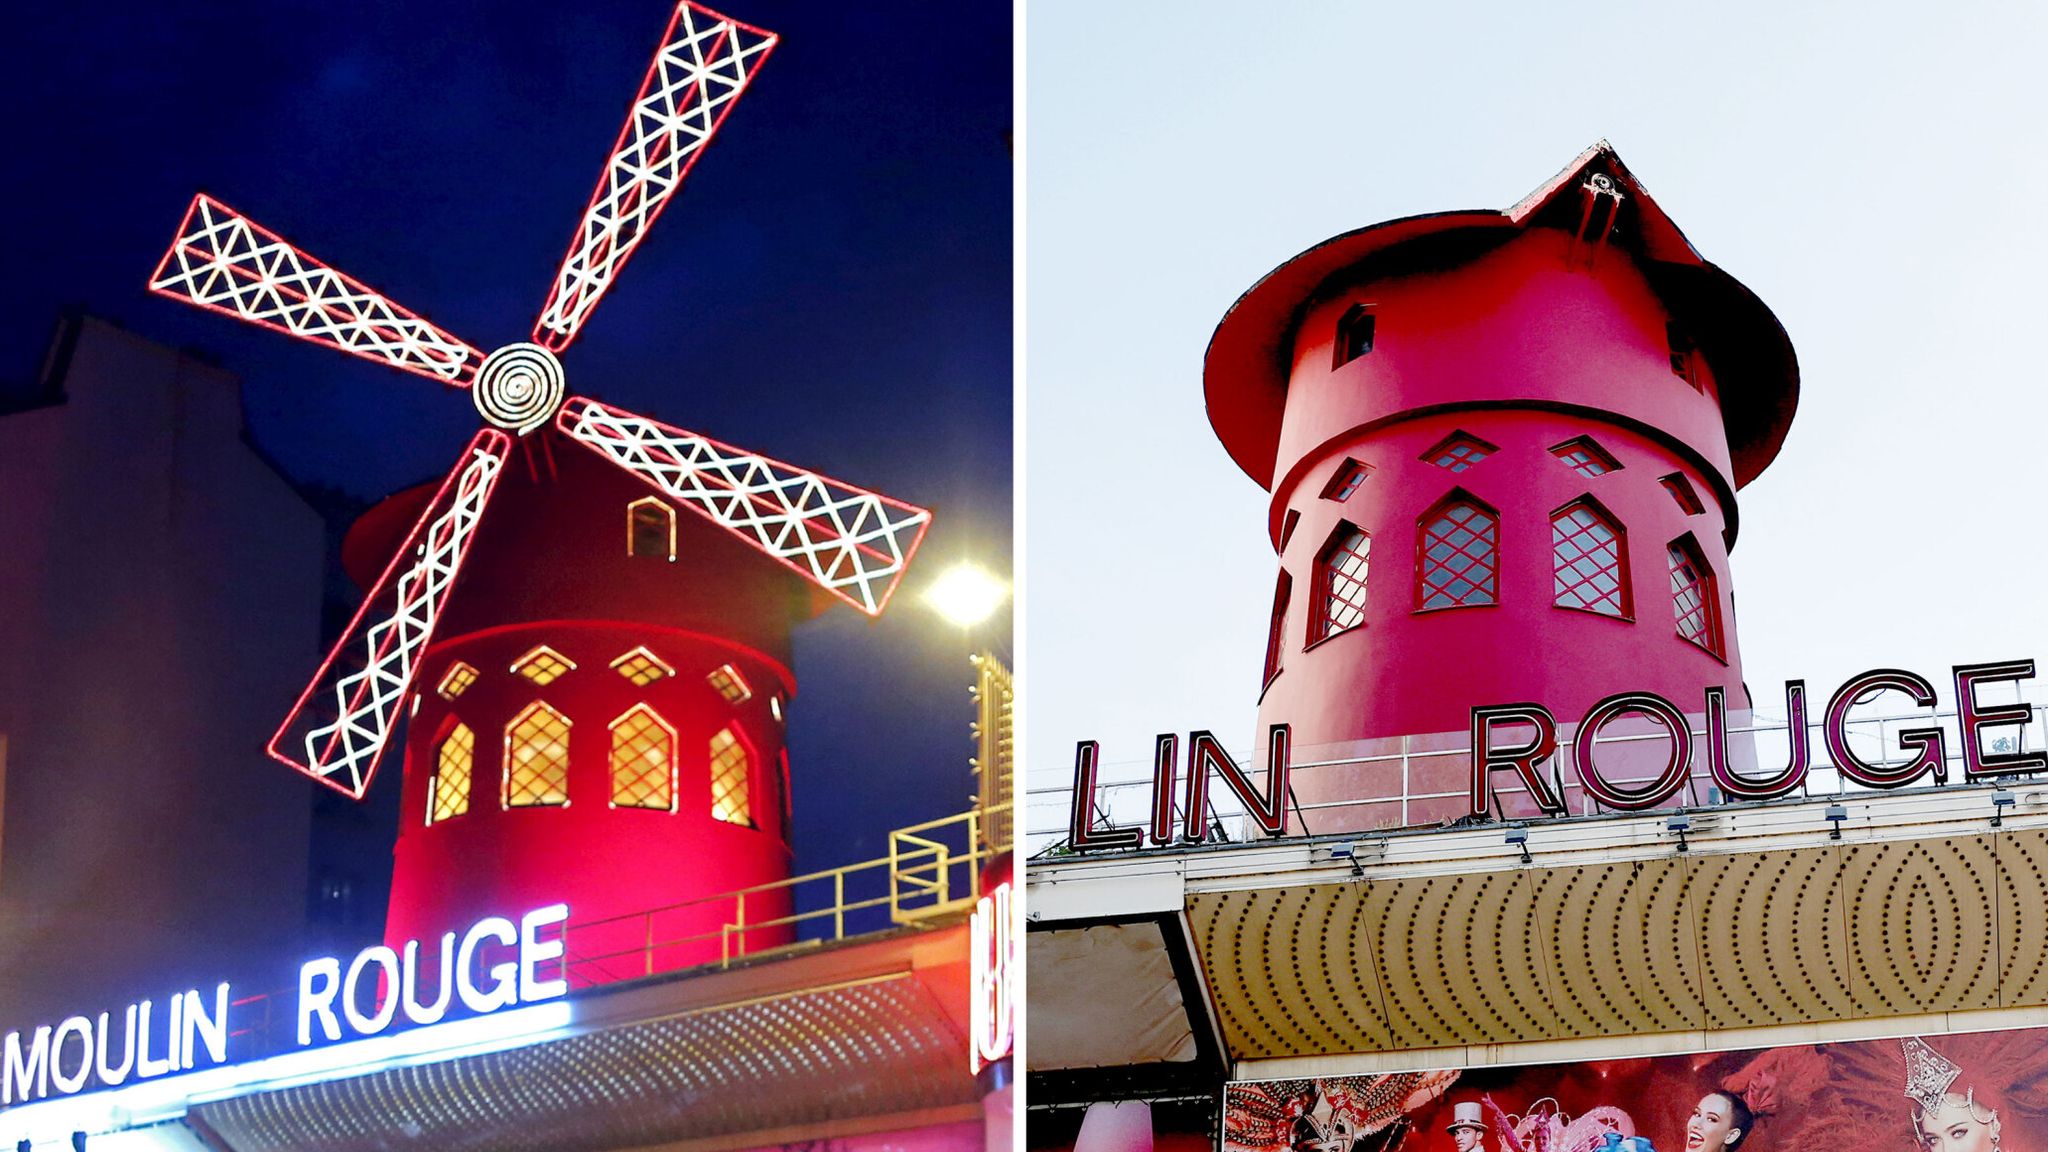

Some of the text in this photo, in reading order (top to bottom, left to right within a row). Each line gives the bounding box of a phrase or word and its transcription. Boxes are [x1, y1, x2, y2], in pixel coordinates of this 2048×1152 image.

[1470, 658, 2047, 817] ROUGE
[3, 903, 569, 1100] MOULIN ROUGE
